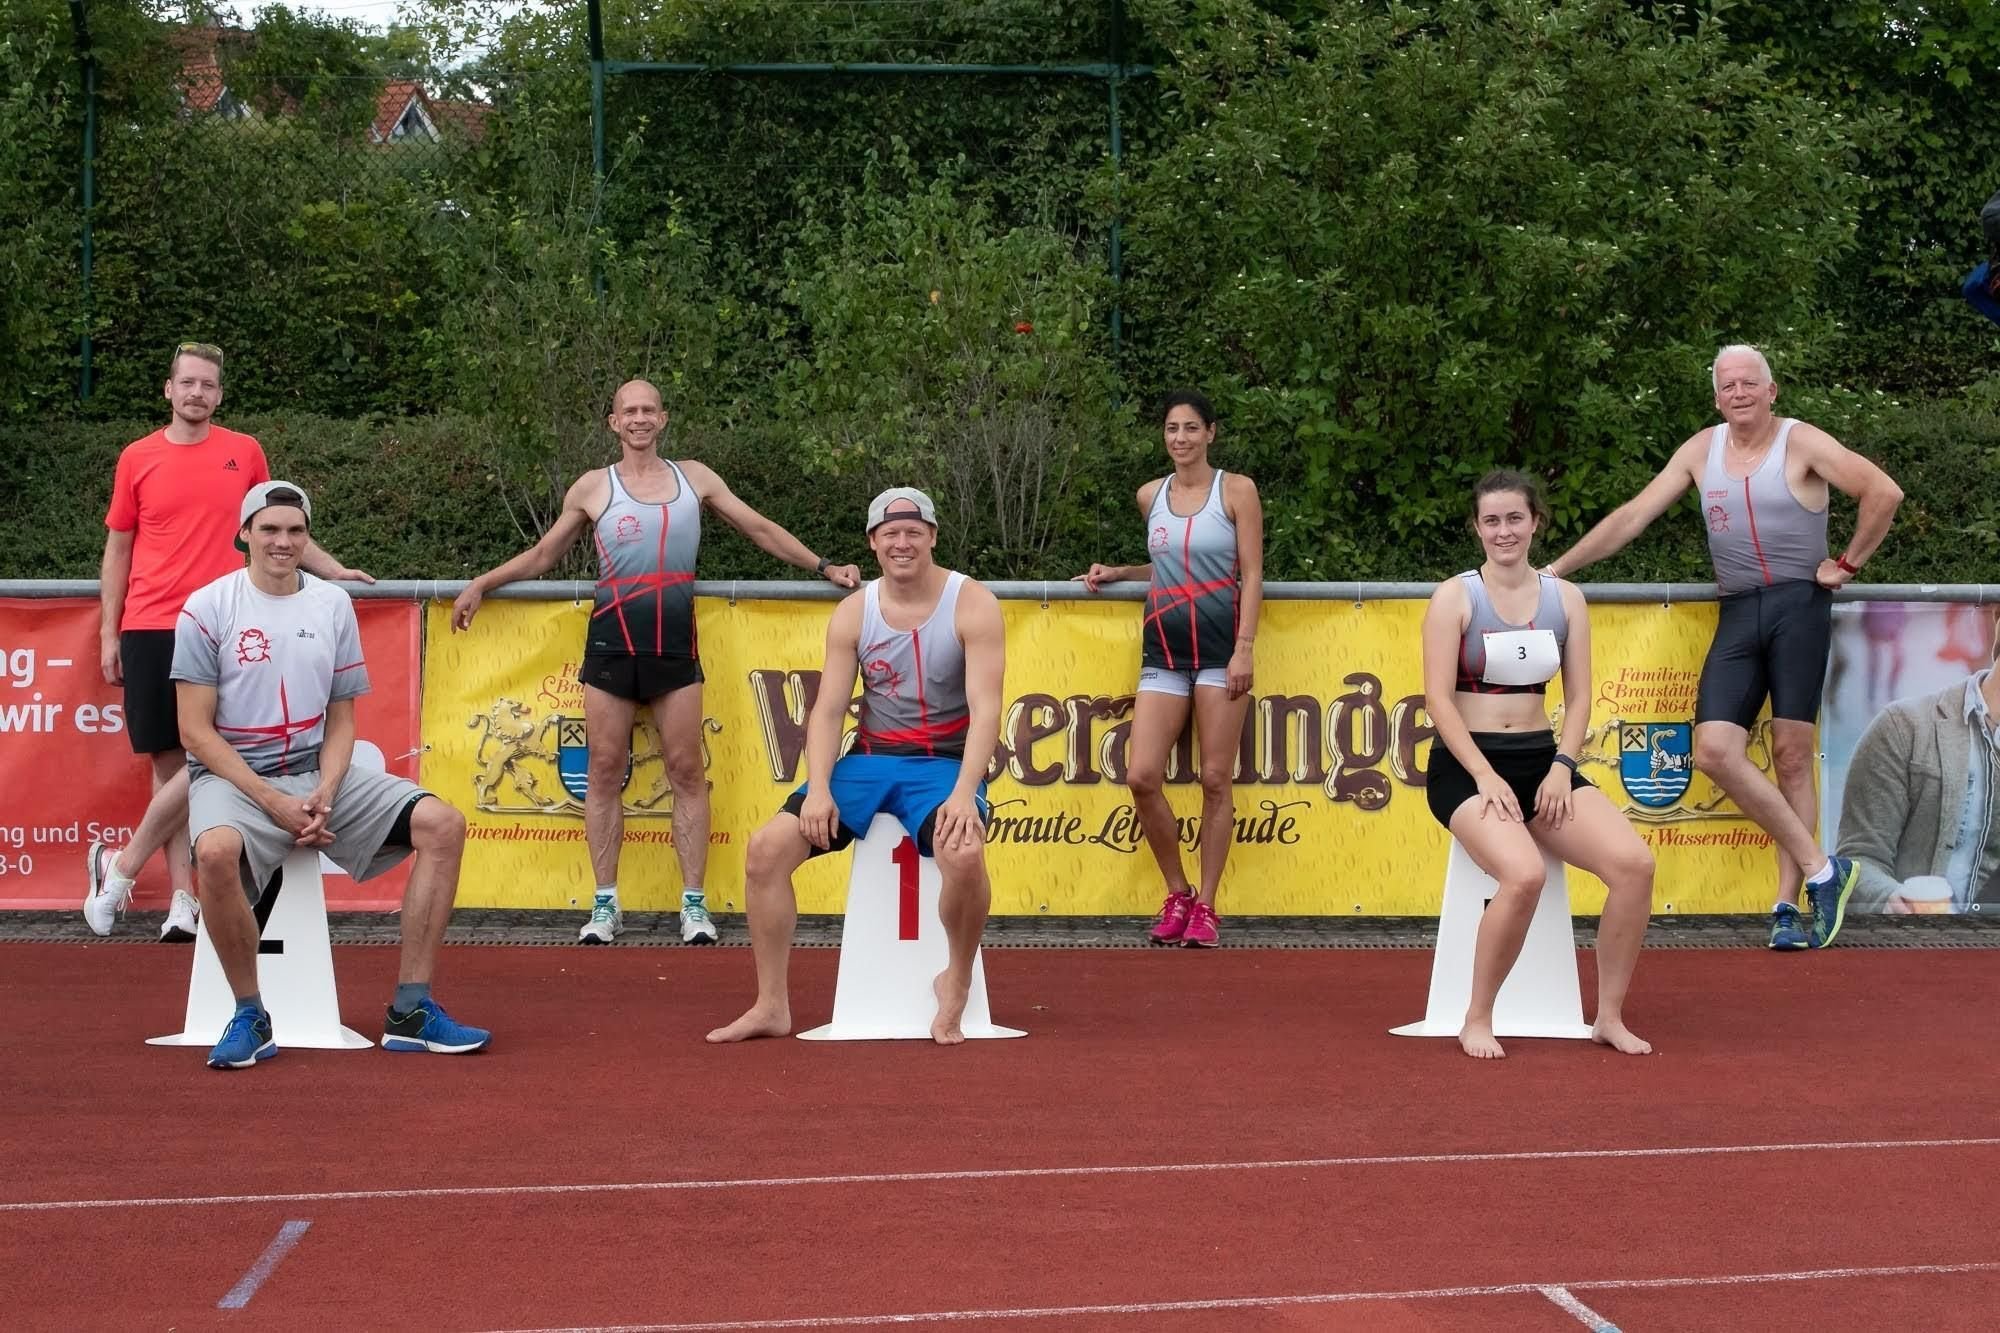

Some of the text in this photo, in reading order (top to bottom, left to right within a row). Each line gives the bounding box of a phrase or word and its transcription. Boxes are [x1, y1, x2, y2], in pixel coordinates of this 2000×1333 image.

[1517, 646, 1528, 660] 3
[1618, 666, 1699, 683] Familien-
[1614, 682, 1698, 699] Braustätte
[0, 691, 125, 734] wir es
[1621, 698, 1690, 714] seit 1864
[33, 820, 80, 843] und
[891, 835, 921, 941] 1
